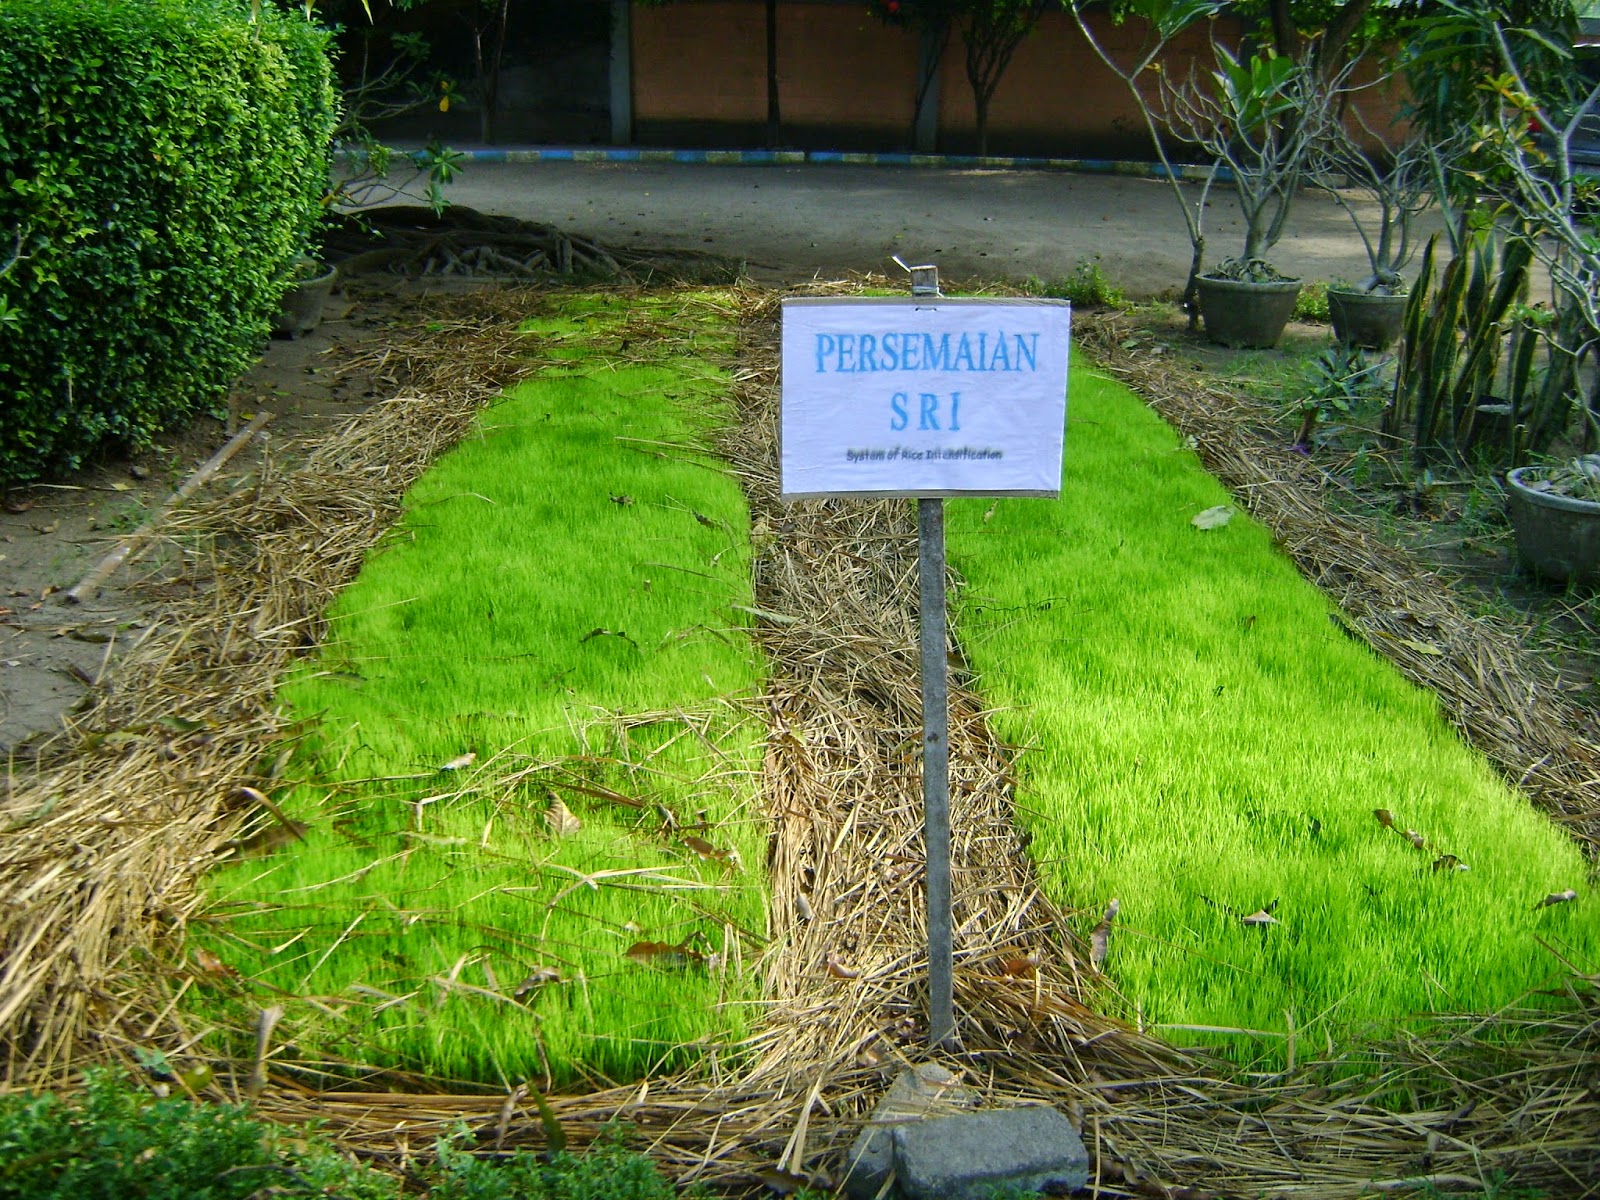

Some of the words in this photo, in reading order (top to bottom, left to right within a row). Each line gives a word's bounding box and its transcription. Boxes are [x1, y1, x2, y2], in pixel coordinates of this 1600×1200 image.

[815, 331, 1040, 373] PERSEMAIAN
[890, 392, 961, 431] SRI
[846, 447, 885, 463] System
[887, 446, 900, 460] of
[902, 448, 923, 460] Rice
[925, 446, 1003, 461] Intensification
